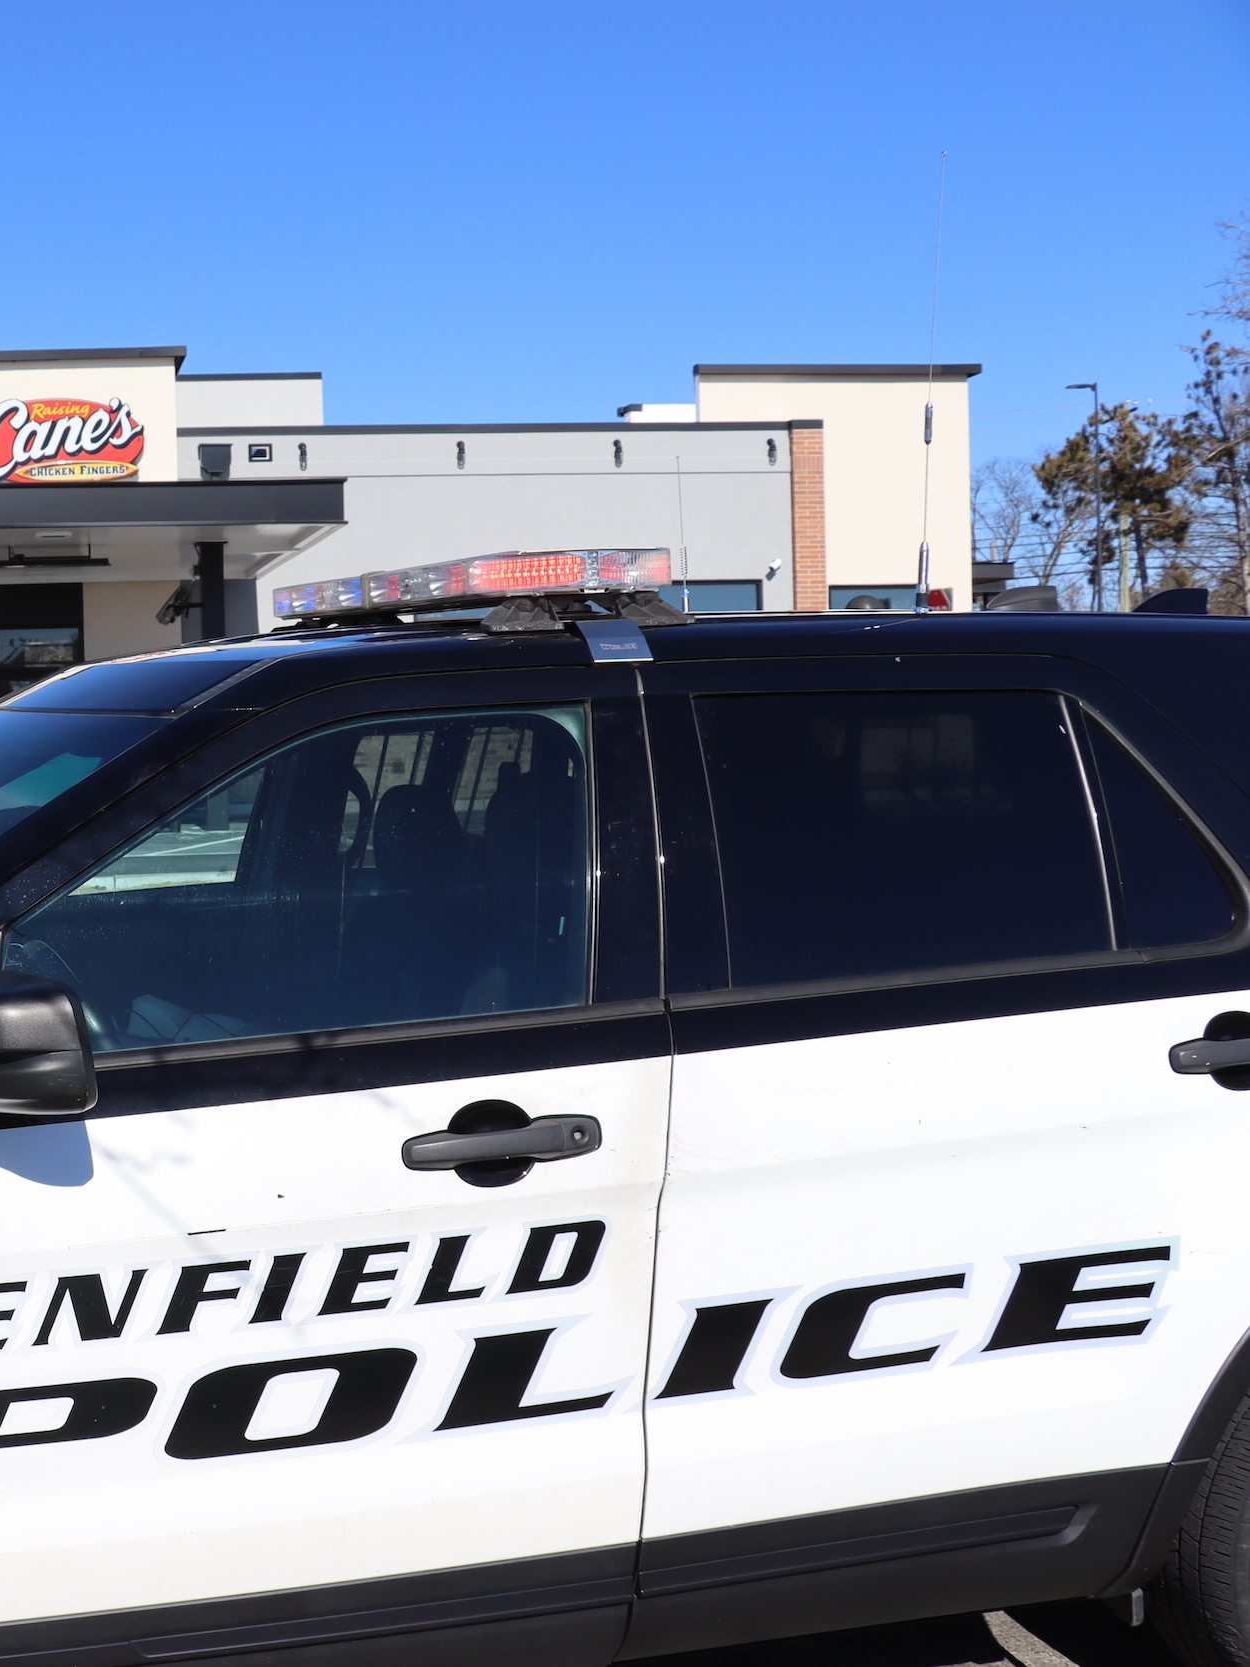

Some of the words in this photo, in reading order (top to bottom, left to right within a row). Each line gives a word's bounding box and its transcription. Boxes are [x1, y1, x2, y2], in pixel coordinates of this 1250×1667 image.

[30, 402, 90, 419] Raising
[29, 466, 76, 476] CHICKEN
[80, 465, 126, 475] FINGERS
